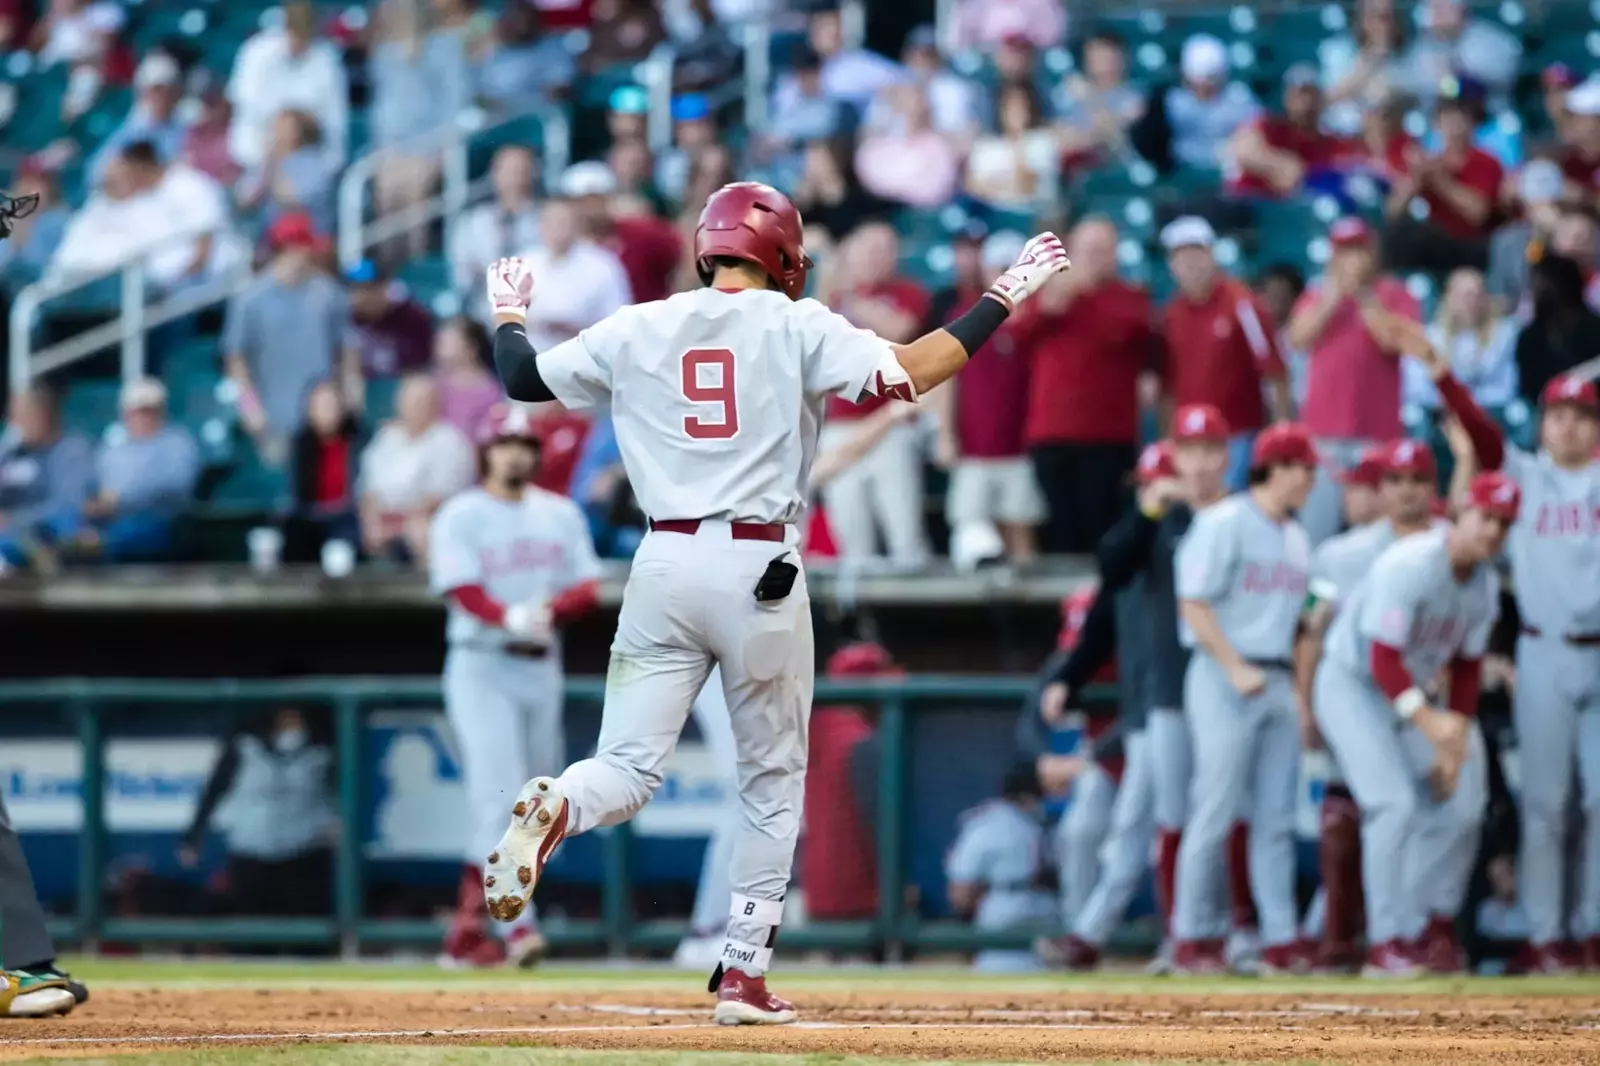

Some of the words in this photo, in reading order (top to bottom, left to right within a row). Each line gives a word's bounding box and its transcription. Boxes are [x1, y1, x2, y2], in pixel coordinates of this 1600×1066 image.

[680, 347, 740, 440] 9
[743, 901, 756, 916] B
[722, 943, 756, 963] Fowl
